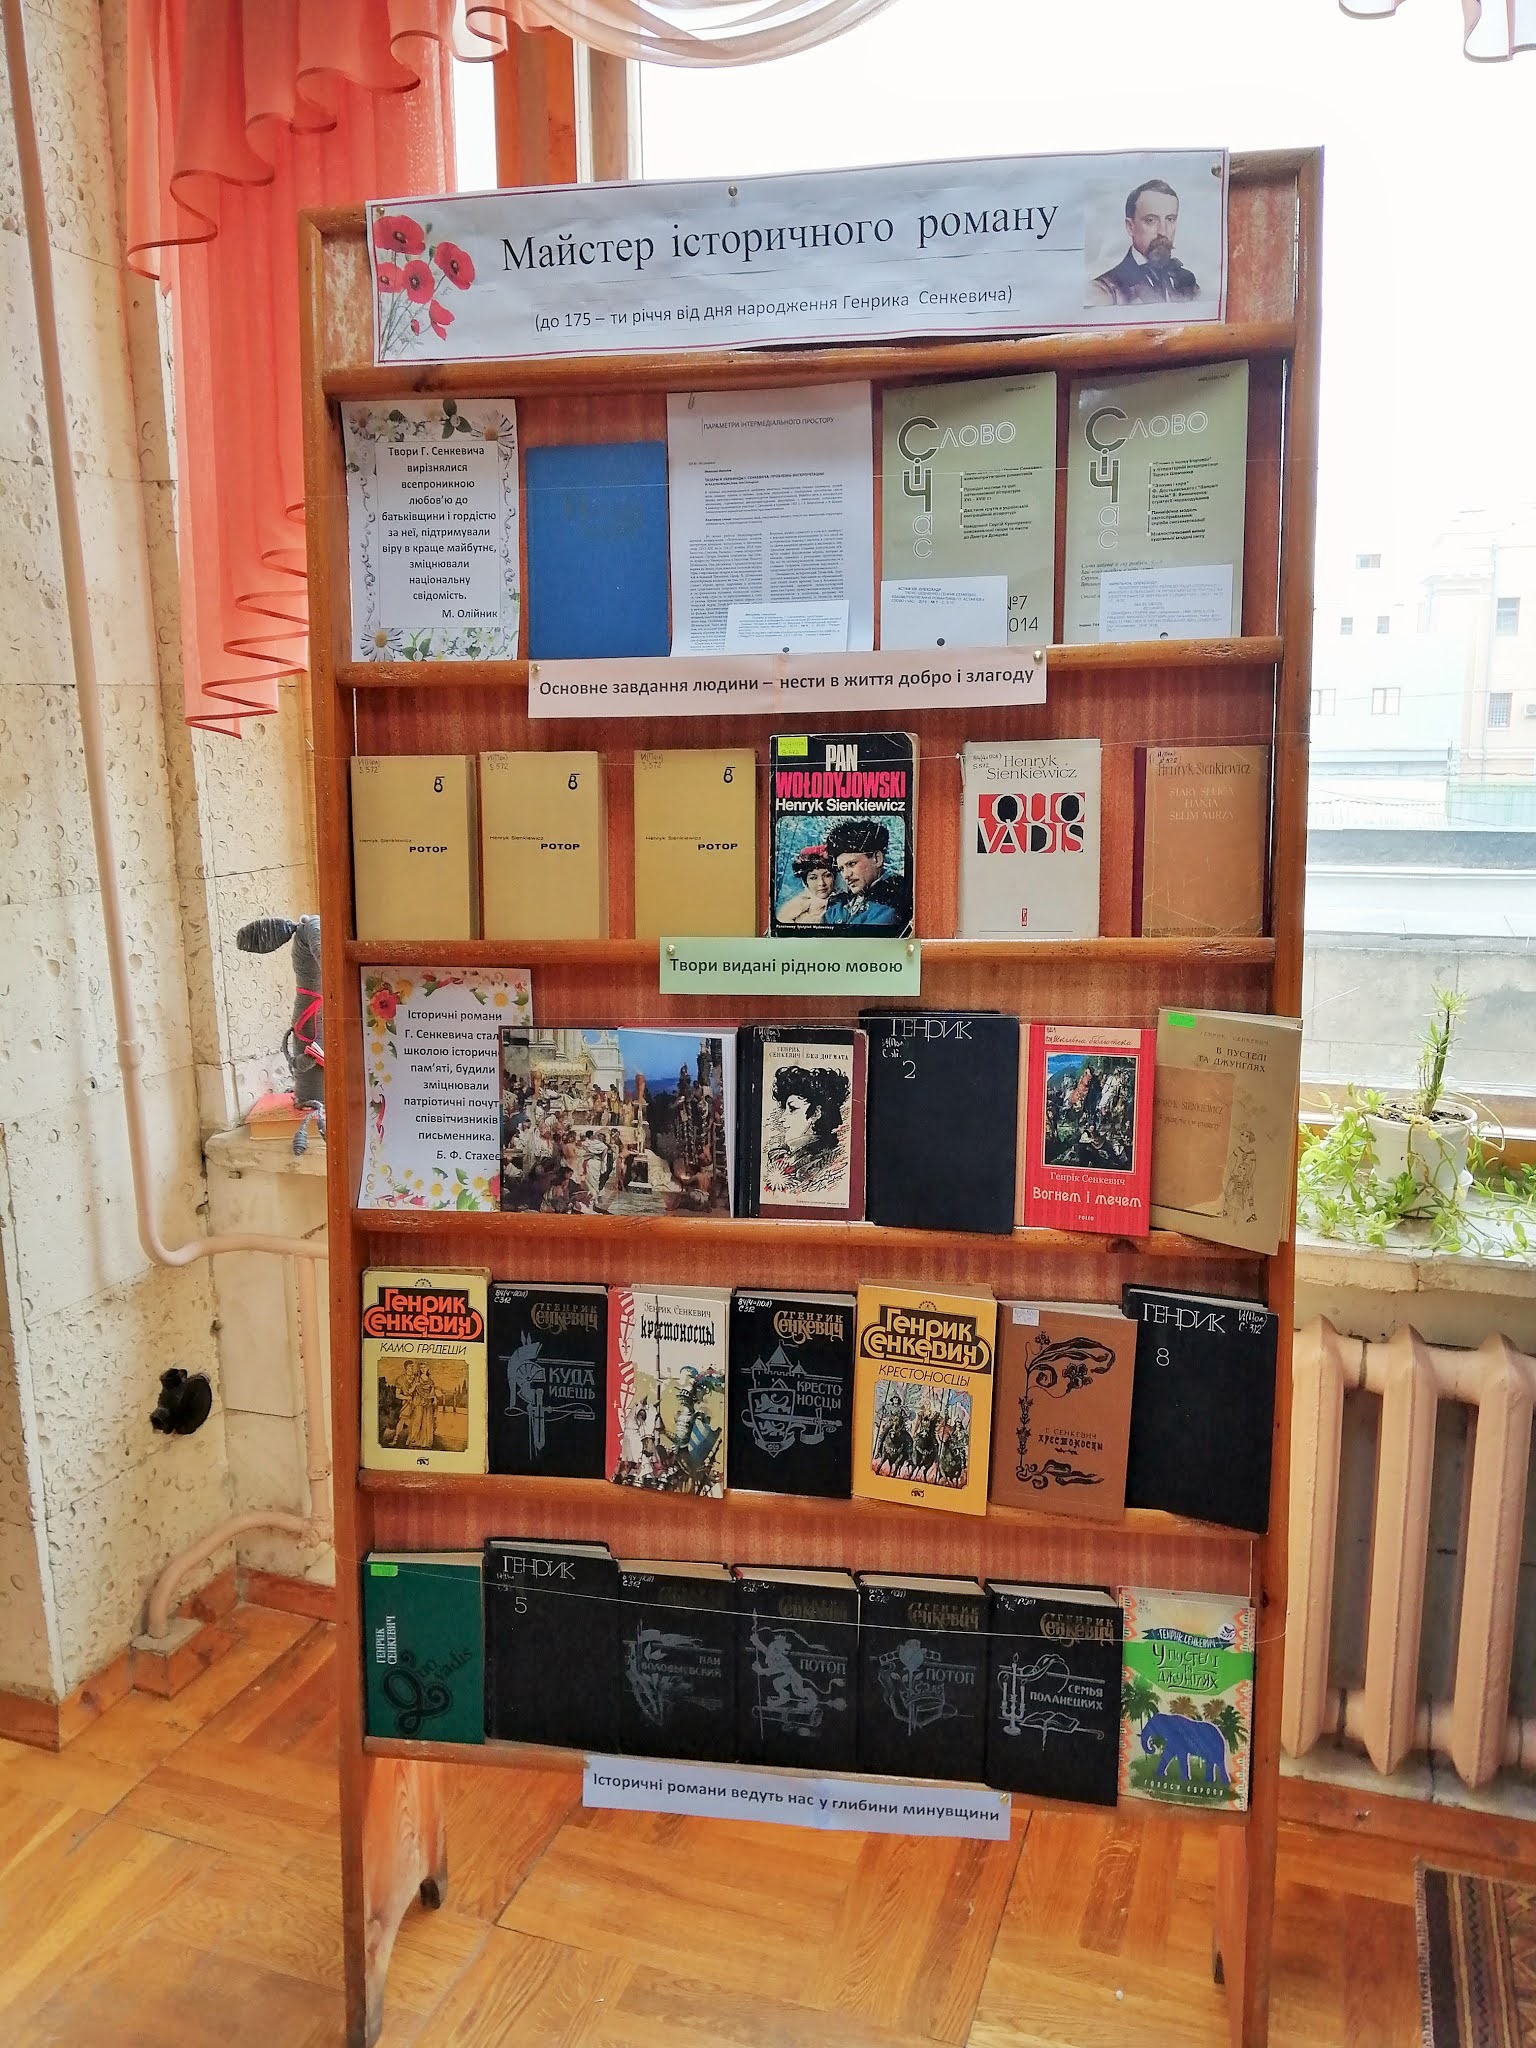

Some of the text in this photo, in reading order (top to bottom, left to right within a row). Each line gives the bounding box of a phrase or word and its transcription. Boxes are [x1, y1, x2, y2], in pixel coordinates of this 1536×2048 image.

[502, 202, 1059, 273] Майстер історичного роману
[534, 285, 1013, 333] (до 175 ти річчя від дня народження Генрика Сенкевича)
[388, 446, 485, 458] Твори Г. Сенкевича
[407, 463, 468, 474] вирізнялися
[401, 480, 474, 490] всепроникною
[455, 497, 468, 506] до
[382, 511, 497, 523] батьківщини і гордістю
[402, 528, 418, 538] неї,
[421, 527, 490, 538] підтримували
[382, 544, 402, 555] віру
[413, 546, 444, 554] краще
[447, 544, 497, 554] майбутнє,
[409, 560, 469, 570] зміцнювали
[409, 575, 470, 586] національну
[413, 591, 467, 602] свідомість.
[442, 609, 497, 618] М. Олійник
[1009, 617, 1038, 632] 014
[540, 668, 1034, 695] Основне завдання людини нести в життя добро і злагоду
[826, 744, 857, 772] PAN
[1004, 755, 1057, 769] Henryk
[987, 765, 1077, 780] Sienkiewicz
[1196, 762, 1251, 775] Sienkiewicz
[776, 771, 906, 799] WOŁODYJOWSKI
[776, 799, 905, 813] Henryk Sienkiewicz
[991, 793, 1085, 823] QUO
[977, 818, 1084, 854] VADIS
[670, 959, 902, 975] Твори видані рідною мовою
[408, 1010, 502, 1023] Історичні романи
[405, 1029, 499, 1040] Г. Сенкевича стал
[891, 1019, 973, 1042] ГЕНРИК
[404, 1046, 500, 1057] школою історичн
[1227, 1048, 1267, 1062] ПУСТЕЛІ
[456, 1064, 495, 1075] будили
[903, 1060, 916, 1079] 2
[1198, 1055, 1266, 1072] ТА ДЖУНГЛЯХ
[423, 1081, 489, 1092] зміцнювали
[404, 1098, 499, 1109] патріотичні почут
[1181, 1102, 1223, 1115] SIENKIEWICZ
[415, 1114, 498, 1126] співвітчизників
[418, 1131, 495, 1142] письменника.
[437, 1151, 501, 1161] Б. Ф. Стахеє
[1050, 1172, 1125, 1185] Генрік Сенкевич
[1033, 1187, 1142, 1207] Вогнем і мечем
[385, 1289, 466, 1316] Генрик
[546, 1303, 597, 1313] ГЕНРИК
[644, 1301, 711, 1318] ГЕНРИК СЕНКЕВИЧ
[364, 1305, 483, 1340] Сенкевич
[531, 1303, 598, 1334] Сенкевич
[789, 1312, 843, 1323] ГЕНРИК
[887, 1308, 972, 1342] Генрик
[1143, 1303, 1226, 1334] ГЕНРИК
[774, 1310, 844, 1344] Сенкевич
[380, 1342, 467, 1355] КАМО ГРЯДЕШИ
[863, 1326, 989, 1370] Сенкевич
[1156, 1347, 1170, 1366] 8
[549, 1366, 595, 1386] КУДА
[879, 1364, 970, 1387] КРЕСТОНОСЦЫ
[549, 1385, 595, 1400] ИДЕШЬ
[797, 1381, 843, 1396] КРЕСТО-
[796, 1393, 841, 1410] НОСЦЫ
[1054, 1428, 1096, 1439] СЕНКЕВИЧ
[502, 1556, 575, 1580] ГЕНРИК
[514, 1597, 528, 1614] 5
[1057, 1614, 1114, 1627] ГЕНРИК
[1040, 1612, 1114, 1647] Сенкевич
[376, 1628, 386, 1664] ГЕНРИК
[386, 1615, 397, 1665] СЕНКЕВИЧ
[699, 1656, 721, 1665] ПАН
[1153, 1643, 1165, 1666] У
[800, 1658, 847, 1675] ПОТОП
[925, 1668, 975, 1685] ПОТОП
[1068, 1684, 1104, 1698] СЕМЬЯ
[1030, 1691, 1103, 1711] ПОЛАНЕЦКИХ
[593, 1773, 999, 1823] Історичні романи ведуть нас у глибини минувщини
